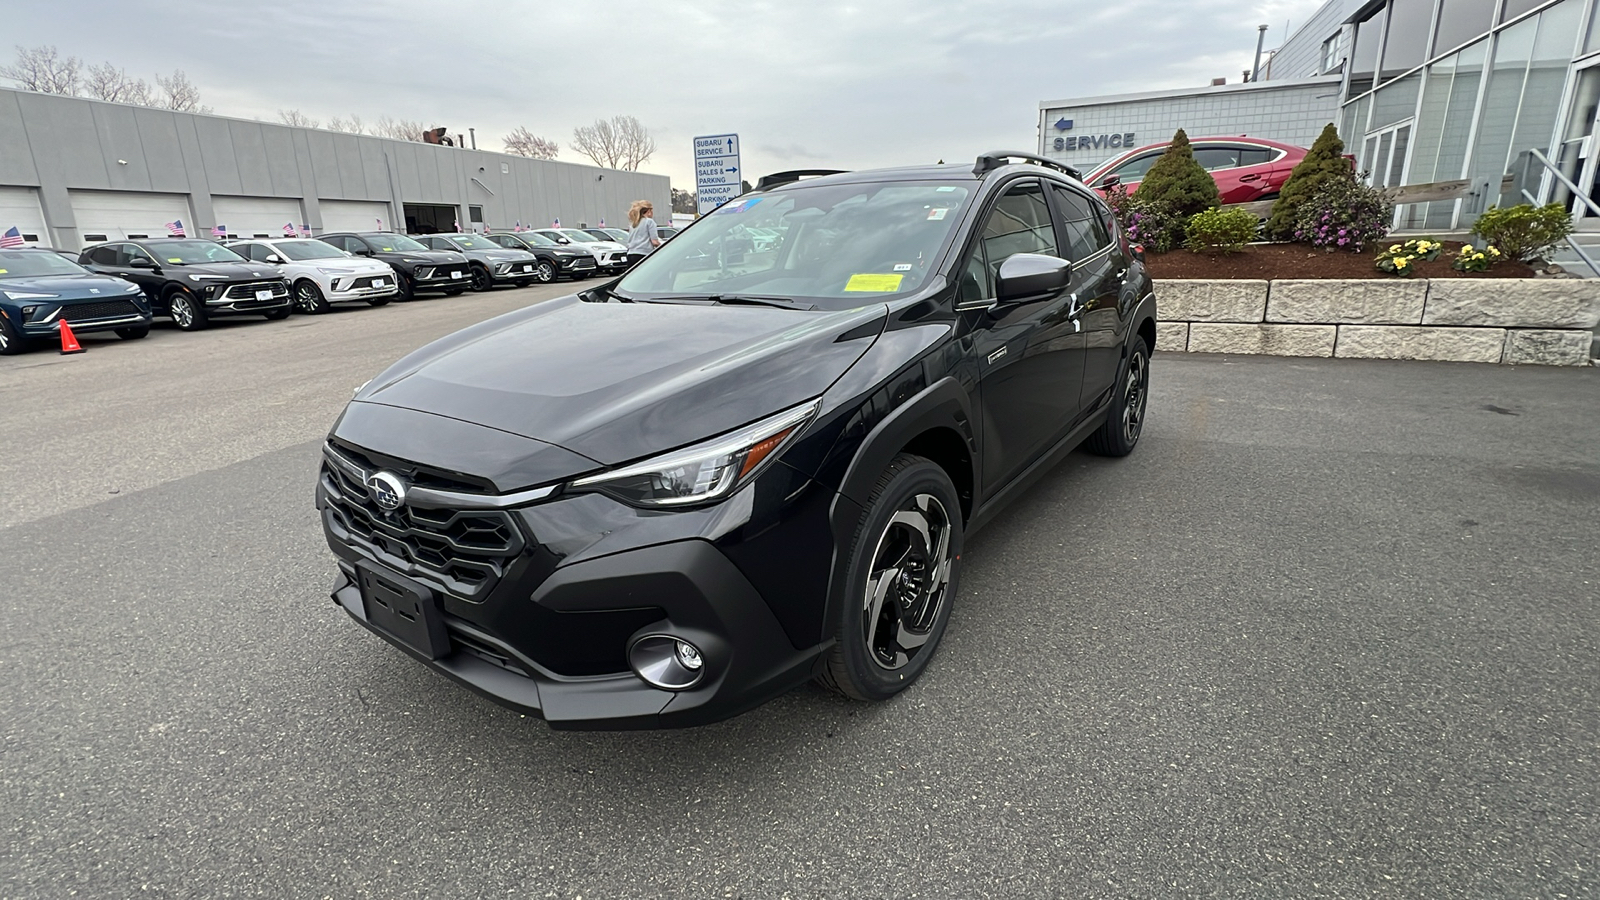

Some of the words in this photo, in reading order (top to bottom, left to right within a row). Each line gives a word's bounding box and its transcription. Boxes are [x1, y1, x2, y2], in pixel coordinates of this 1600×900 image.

[696, 139, 722, 147] SUBARU
[1053, 132, 1135, 151] SERVICE
[697, 148, 723, 156] SERVICE
[698, 160, 723, 168] SUBARU
[698, 168, 718, 176] SALES
[700, 187, 731, 195] HANDICAP
